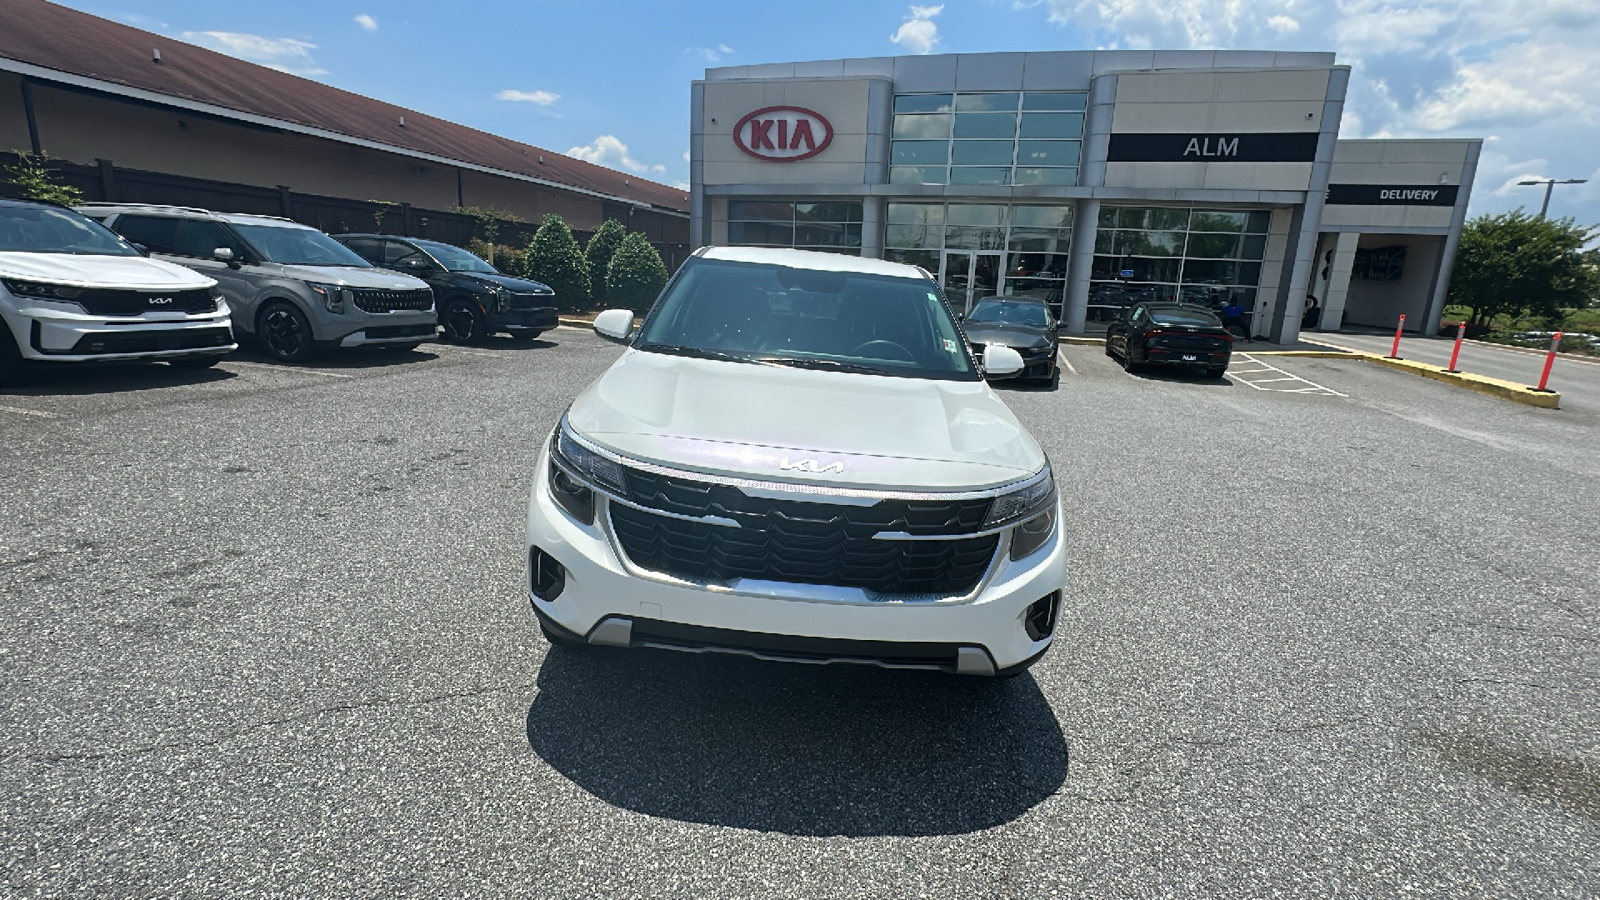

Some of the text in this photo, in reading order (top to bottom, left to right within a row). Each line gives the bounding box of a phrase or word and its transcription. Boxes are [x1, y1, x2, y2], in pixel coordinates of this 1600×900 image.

[750, 119, 815, 149] KIA
[1183, 137, 1239, 156] ALM
[1380, 189, 1438, 200] DELIVERY
[779, 457, 844, 473] KIA
